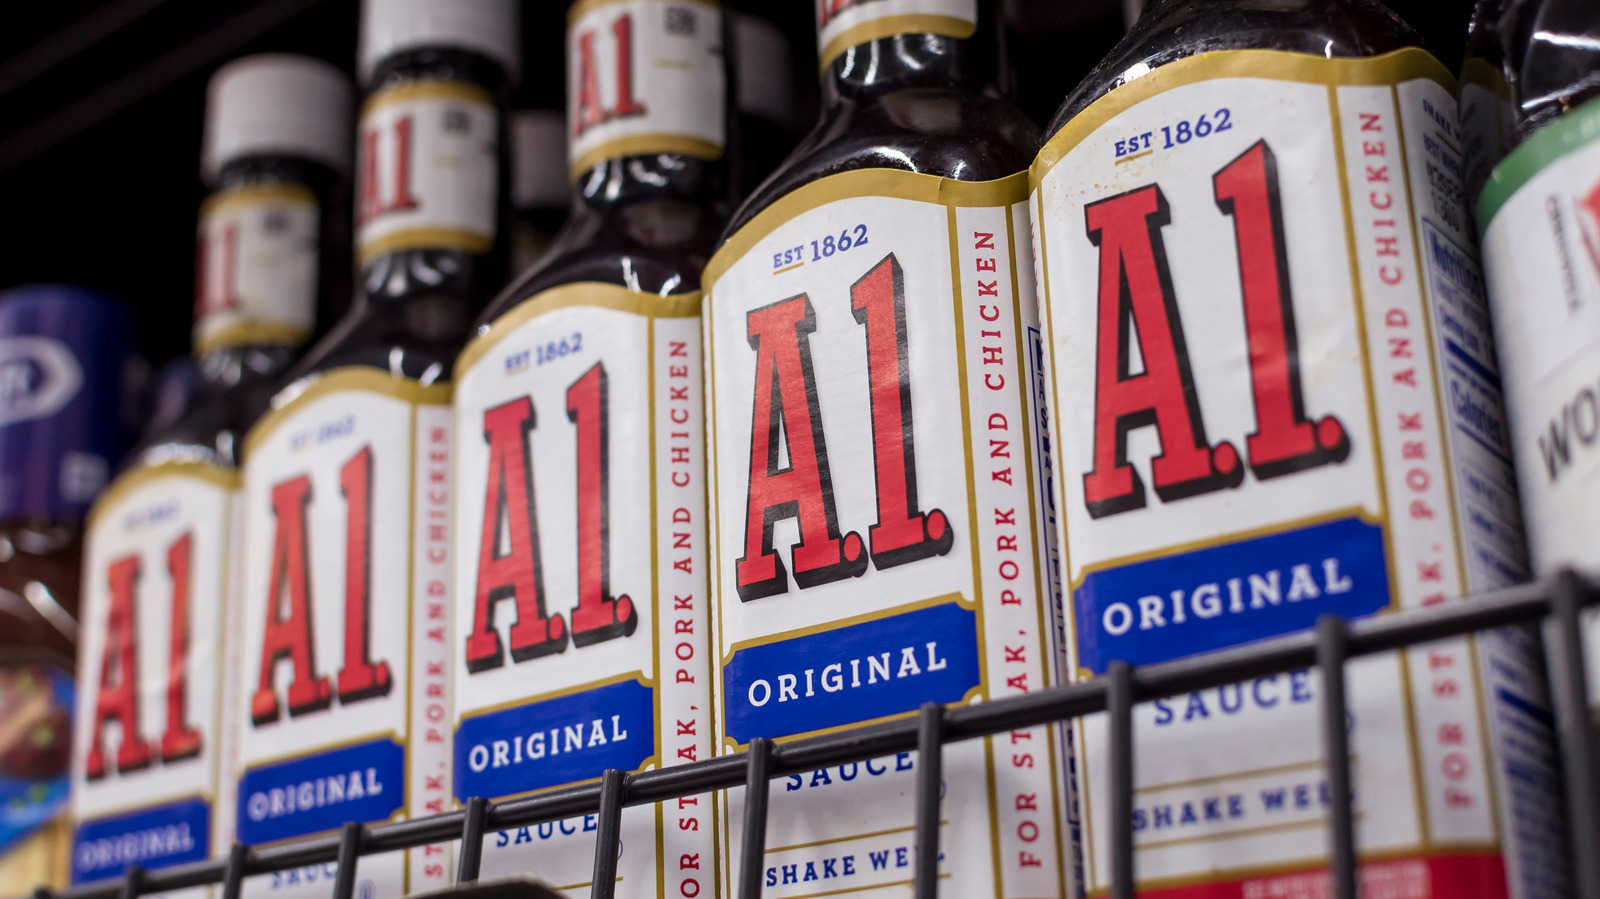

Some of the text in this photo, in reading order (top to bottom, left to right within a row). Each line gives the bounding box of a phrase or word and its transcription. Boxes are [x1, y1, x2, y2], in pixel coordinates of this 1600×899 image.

[1114, 107, 1233, 158] EST 1862
[1359, 111, 1404, 287] CHICKEN
[773, 223, 869, 269] EST 1862
[536, 332, 584, 366] 1862
[1083, 138, 1352, 519] A.1.
[1385, 308, 1418, 389] AND
[669, 340, 691, 488] CHICKEN
[736, 252, 954, 603] A.1.
[1397, 411, 1436, 521] PORK
[466, 361, 638, 675] A.1.
[672, 506, 692, 575] AND
[974, 230, 1042, 870] FOR STAK, PORK AND CHICKEN
[1102, 557, 1352, 637] ORIGINAL
[425, 425, 449, 879] STAK, PORK AND CHICKEN
[674, 594, 695, 684] PORK
[747, 641, 948, 708] ORIGINAL
[1153, 667, 1313, 727] SAUCE
[468, 714, 628, 773] ORIGINAL
[677, 705, 699, 832] STAK,
[786, 752, 914, 792] SAUCE
[247, 767, 383, 822] ORIGINAL
[1131, 793, 1245, 833] SHAKE
[77, 821, 195, 873] ORIGINAL
[496, 814, 598, 848] SAUCE
[766, 855, 856, 887] SHAKE
